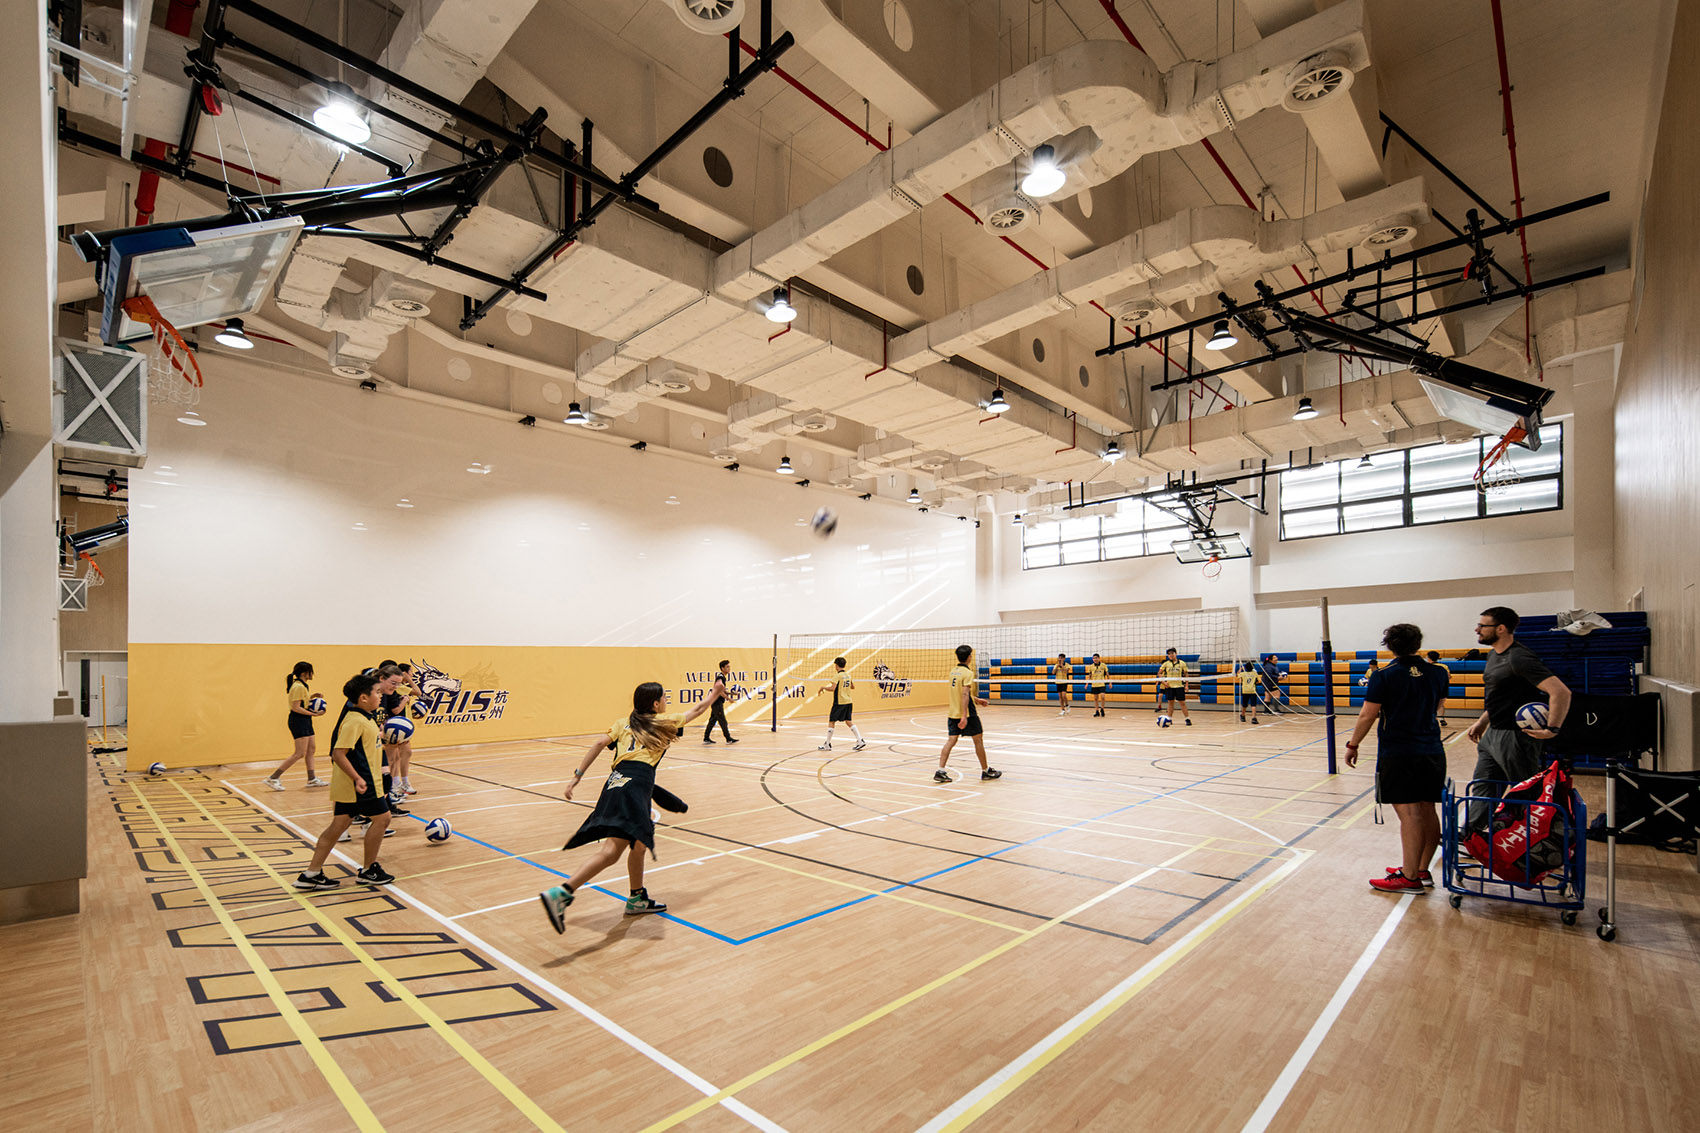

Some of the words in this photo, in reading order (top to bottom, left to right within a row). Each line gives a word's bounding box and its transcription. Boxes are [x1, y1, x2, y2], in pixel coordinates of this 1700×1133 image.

[686, 671, 749, 683] WELOME
[753, 671, 768, 681] TO
[842, 680, 851, 688] 15
[884, 678, 908, 693] HIS
[430, 690, 495, 715] HIS
[680, 686, 767, 704] DRAON'S
[776, 685, 805, 699] AIR
[488, 690, 510, 720] 杭州
[424, 712, 489, 725] DRAGONS
[107, 786, 558, 1056] HANGZHOU
